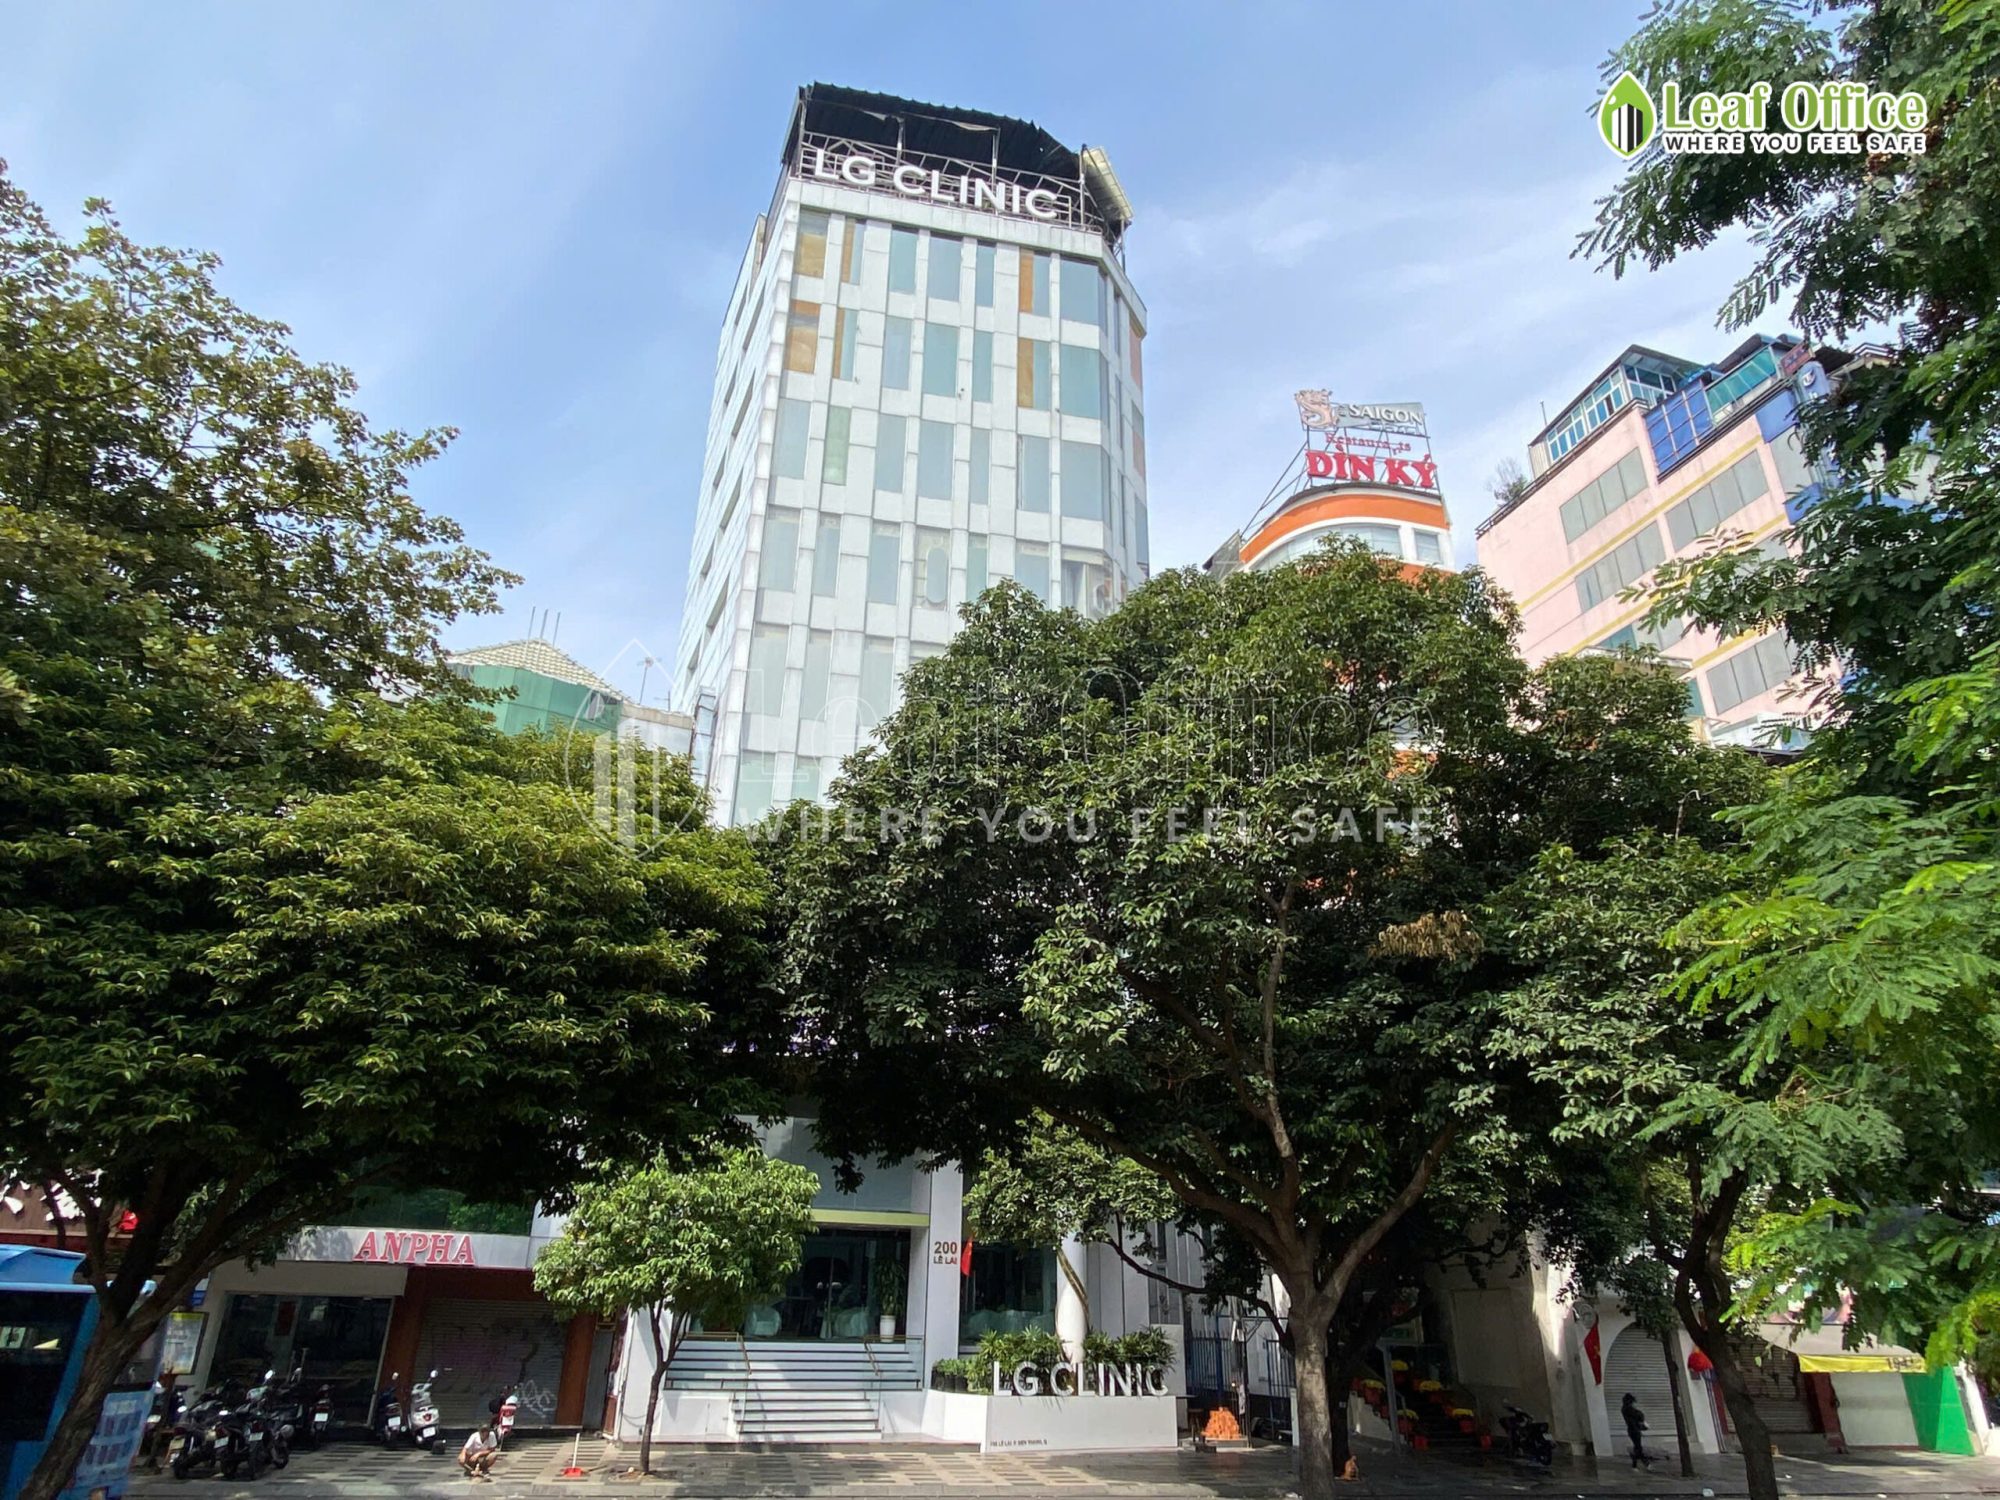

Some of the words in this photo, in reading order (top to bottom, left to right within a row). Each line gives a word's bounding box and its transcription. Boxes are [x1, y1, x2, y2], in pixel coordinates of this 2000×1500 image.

[815, 149, 875, 187] LG
[893, 165, 1058, 219] CLINIC
[1349, 405, 1422, 425] SAIGON
[353, 1230, 475, 1265] ANPHA
[934, 1241, 958, 1254] 200
[945, 1256, 958, 1264] LAI
[994, 1361, 1039, 1396] LG
[1051, 1361, 1169, 1396] CLINIC
